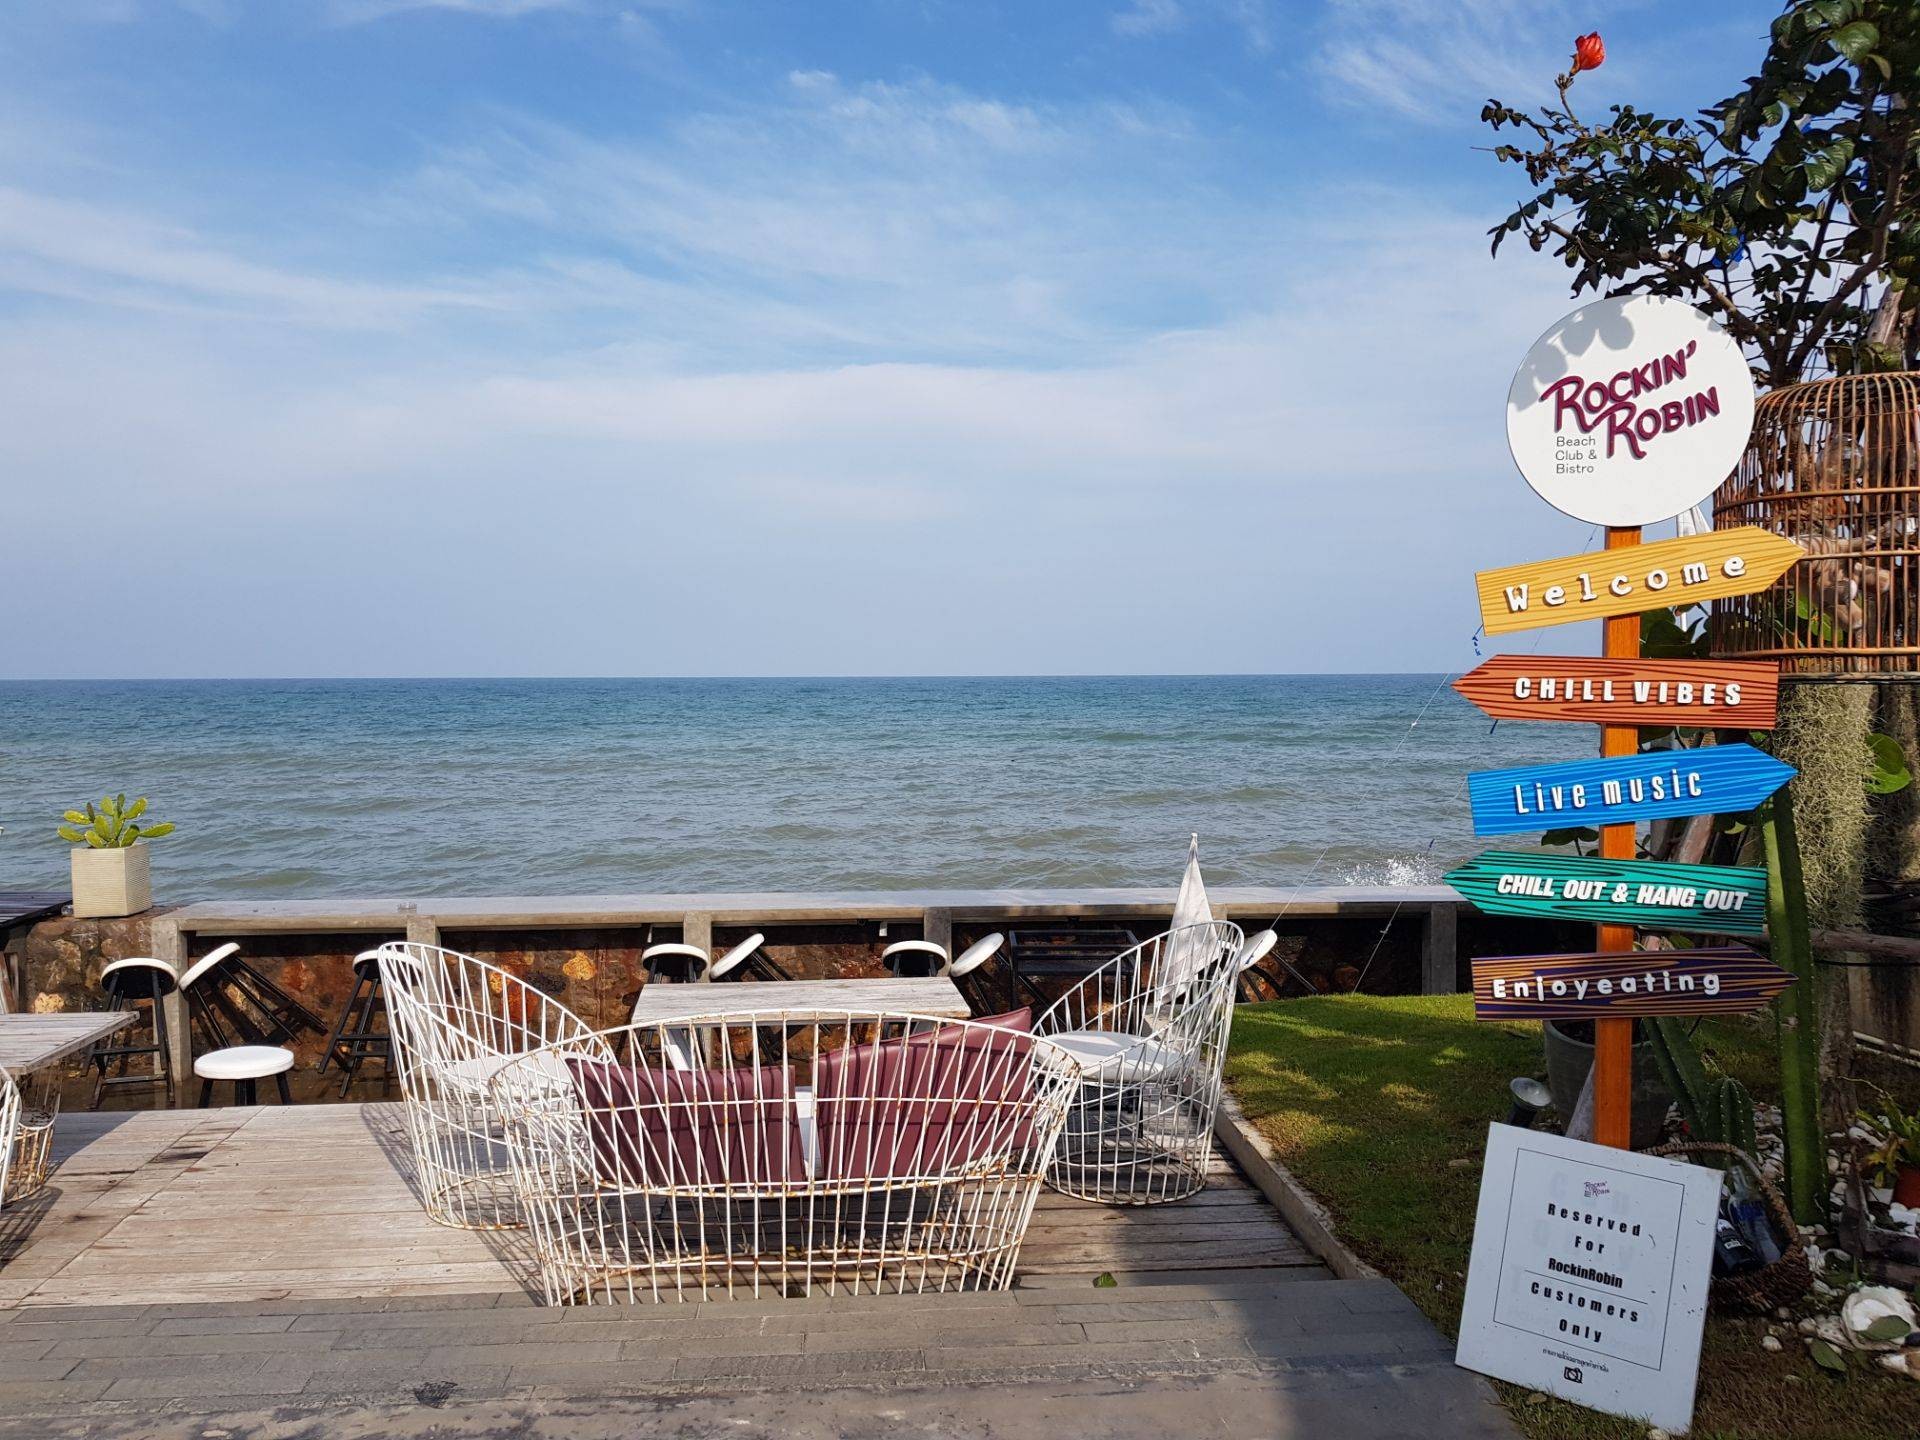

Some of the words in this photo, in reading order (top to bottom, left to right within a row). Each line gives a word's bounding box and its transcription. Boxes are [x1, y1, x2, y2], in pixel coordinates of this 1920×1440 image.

[1592, 386, 1720, 460] ROBIN
[1555, 436, 1597, 447] Beach
[1555, 450, 1584, 461] Club
[1588, 450, 1598, 461] &
[1555, 463, 1595, 475] Bistro
[1504, 555, 1747, 614] Welcome
[1515, 677, 1615, 703] CHILL
[1633, 680, 1742, 706] VIBES
[1514, 782, 1587, 815] Live
[1603, 768, 1703, 806] music
[1497, 874, 1555, 898] CHILL
[1562, 880, 1608, 901] OUT
[1612, 883, 1629, 903] &
[1636, 884, 1697, 909] HANG
[1702, 889, 1750, 911] OUT
[1547, 1203, 1642, 1237] Reserved
[1574, 1235, 1606, 1255] For
[1548, 1257, 1624, 1289] RockinRobin
[1530, 1281, 1639, 1323] Customers
[1558, 1318, 1603, 1344] Only
